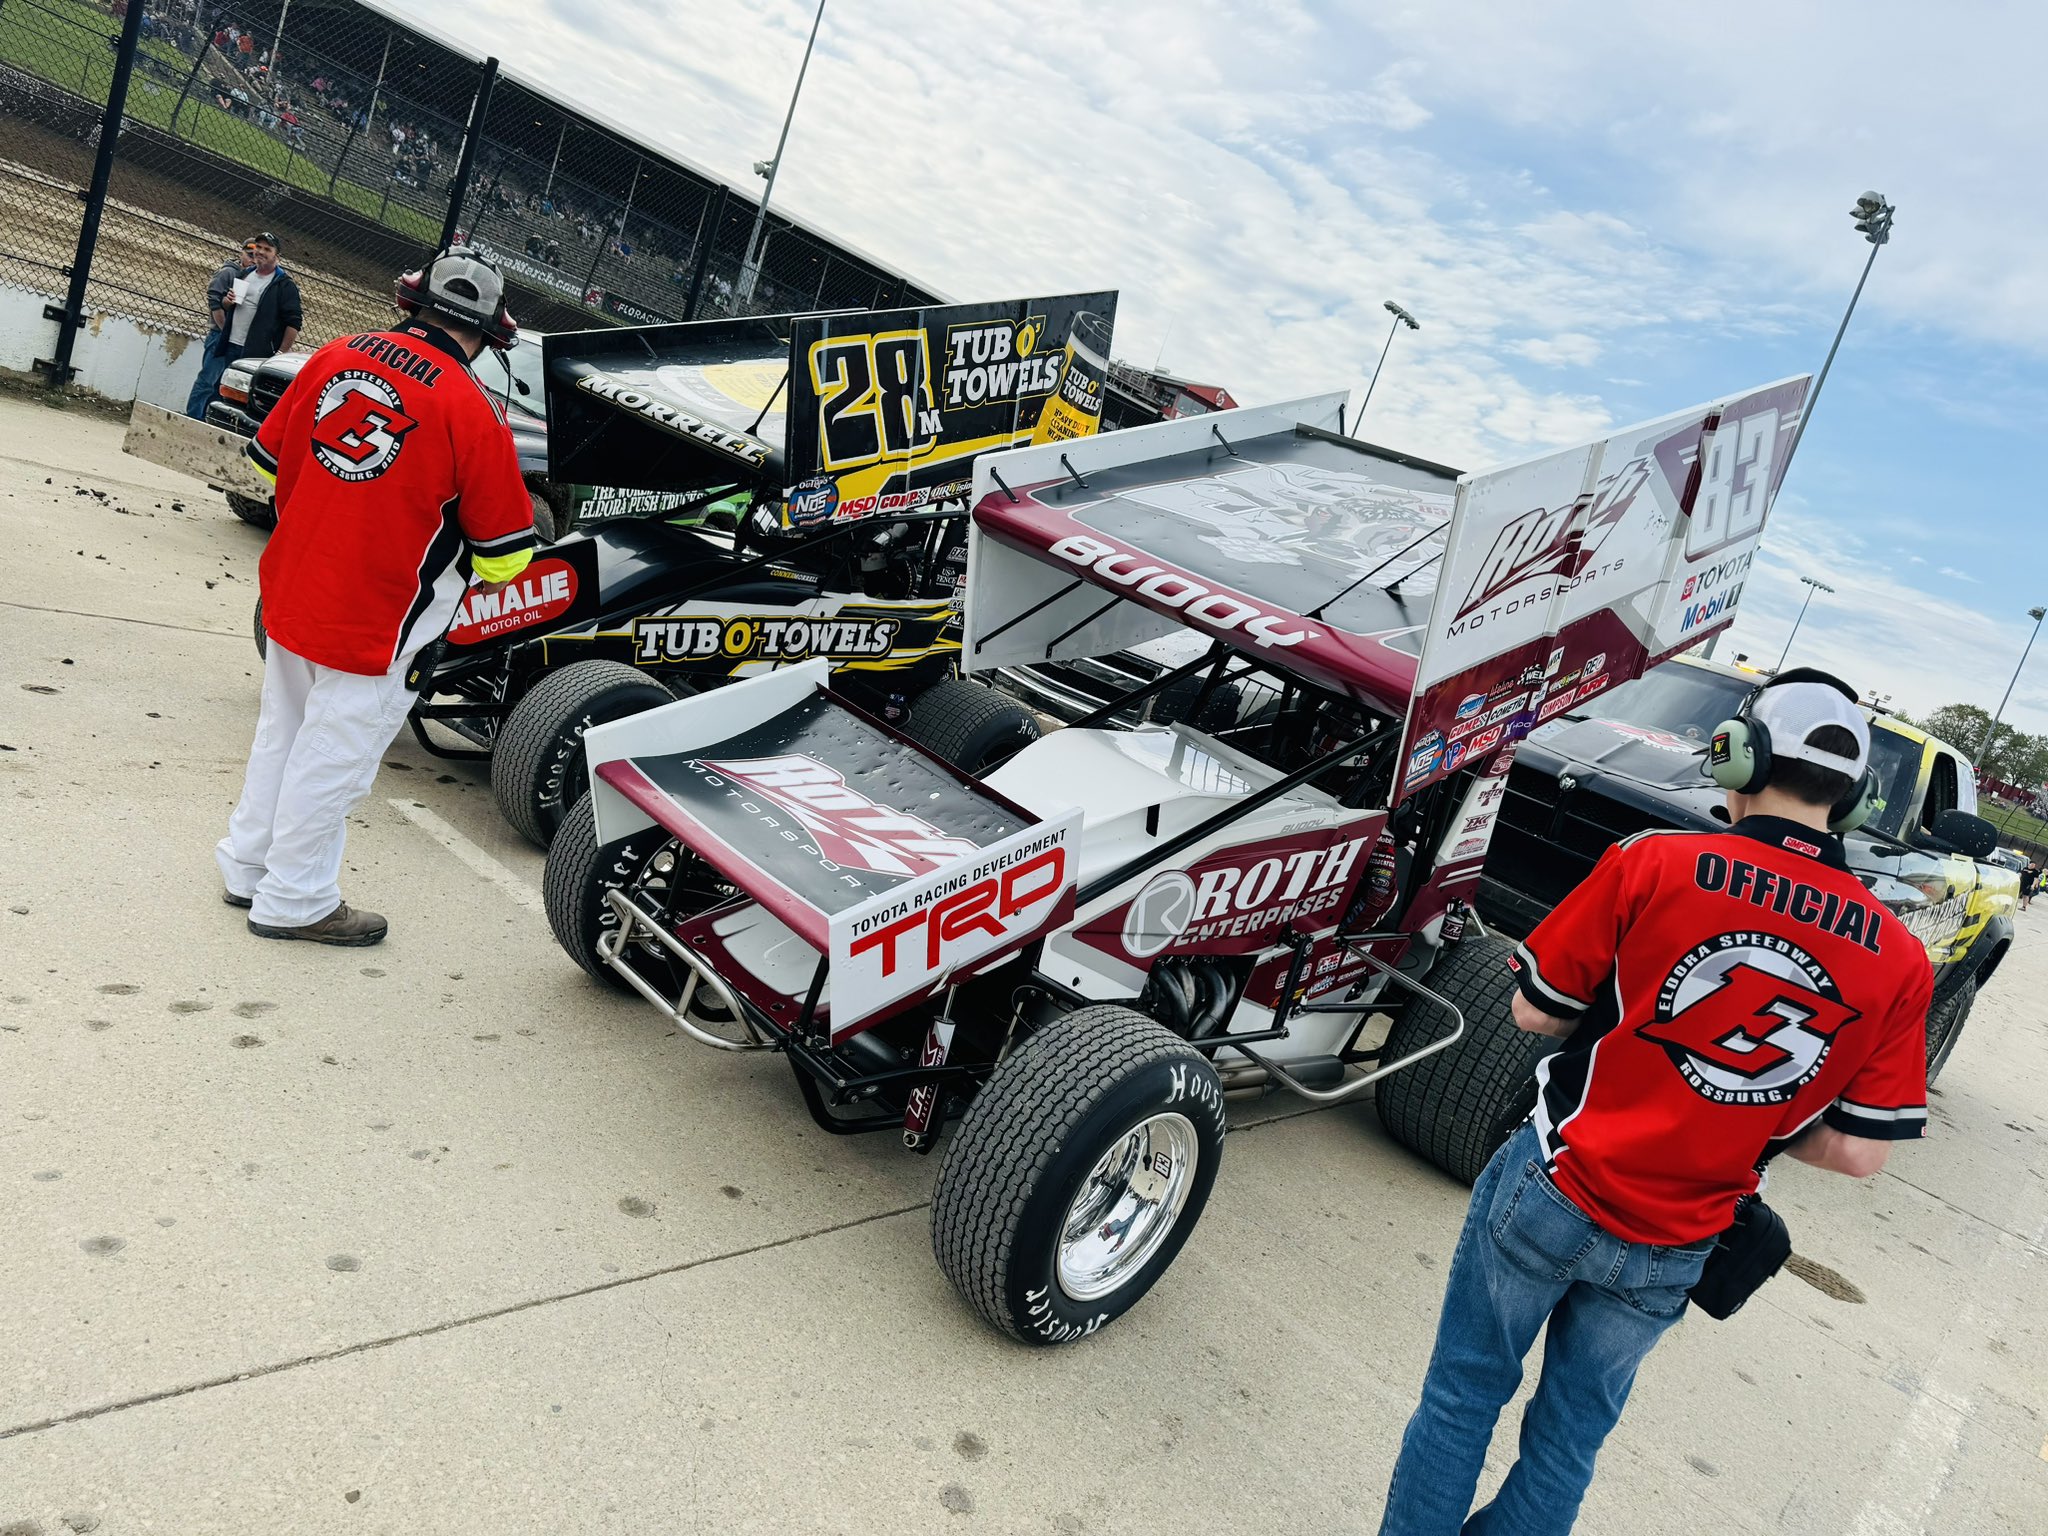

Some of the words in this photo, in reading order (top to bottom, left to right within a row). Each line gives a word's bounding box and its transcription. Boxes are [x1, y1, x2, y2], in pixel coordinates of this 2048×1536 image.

[346, 333, 444, 390] OFFICIAL
[951, 326, 1013, 367] TUB
[1015, 323, 1041, 359] O'
[344, 371, 401, 406] SPEEDWAY
[947, 354, 1063, 405] TOWELS
[1063, 380, 1101, 411] TOWELS
[1066, 365, 1089, 388] TUB
[578, 374, 766, 464] MORRELL
[812, 330, 936, 468] 28
[918, 409, 944, 436] M
[381, 442, 401, 470] OHIO
[592, 485, 617, 500] THE
[796, 488, 832, 514] NOS
[879, 491, 919, 509] COMP
[1689, 408, 1779, 557] 83
[579, 496, 628, 519] ELDORA
[627, 494, 659, 513] PUSH
[837, 496, 877, 518] MSD
[1696, 550, 1753, 594] TOYOTA
[449, 569, 570, 632] AMALIE
[1446, 557, 1625, 640] MOTORSPORTS
[1680, 589, 1728, 633] Mobil
[480, 616, 521, 636] MOTOR
[524, 609, 542, 623] OIL
[638, 621, 720, 658] TUB
[724, 620, 760, 655] O'
[763, 621, 892, 654] TOWELS
[1525, 669, 1546, 682] WEL
[1490, 695, 1526, 722] COMETIC
[1540, 690, 1574, 719] SIMPSON
[1450, 718, 1481, 738] COMP
[1468, 726, 1502, 753] MSD
[538, 714, 593, 809] Hoosier
[1406, 744, 1440, 777] NOS
[682, 759, 879, 901] MOTORSPORT
[1783, 837, 1821, 856] SIMPSON
[851, 901, 909, 937] TOYOTA
[914, 873, 967, 909] RACING
[972, 828, 1067, 882] DEVELOPMENT
[1191, 835, 1369, 923] ROTH
[849, 846, 1066, 978] TRD
[1173, 886, 1345, 948] ENTERPRISES
[1694, 851, 1882, 956] OFFICIAL
[1657, 944, 1711, 1013] ELDORA
[1718, 934, 1833, 989] SPEEDWAY
[1798, 1045, 1832, 1086] OHIO
